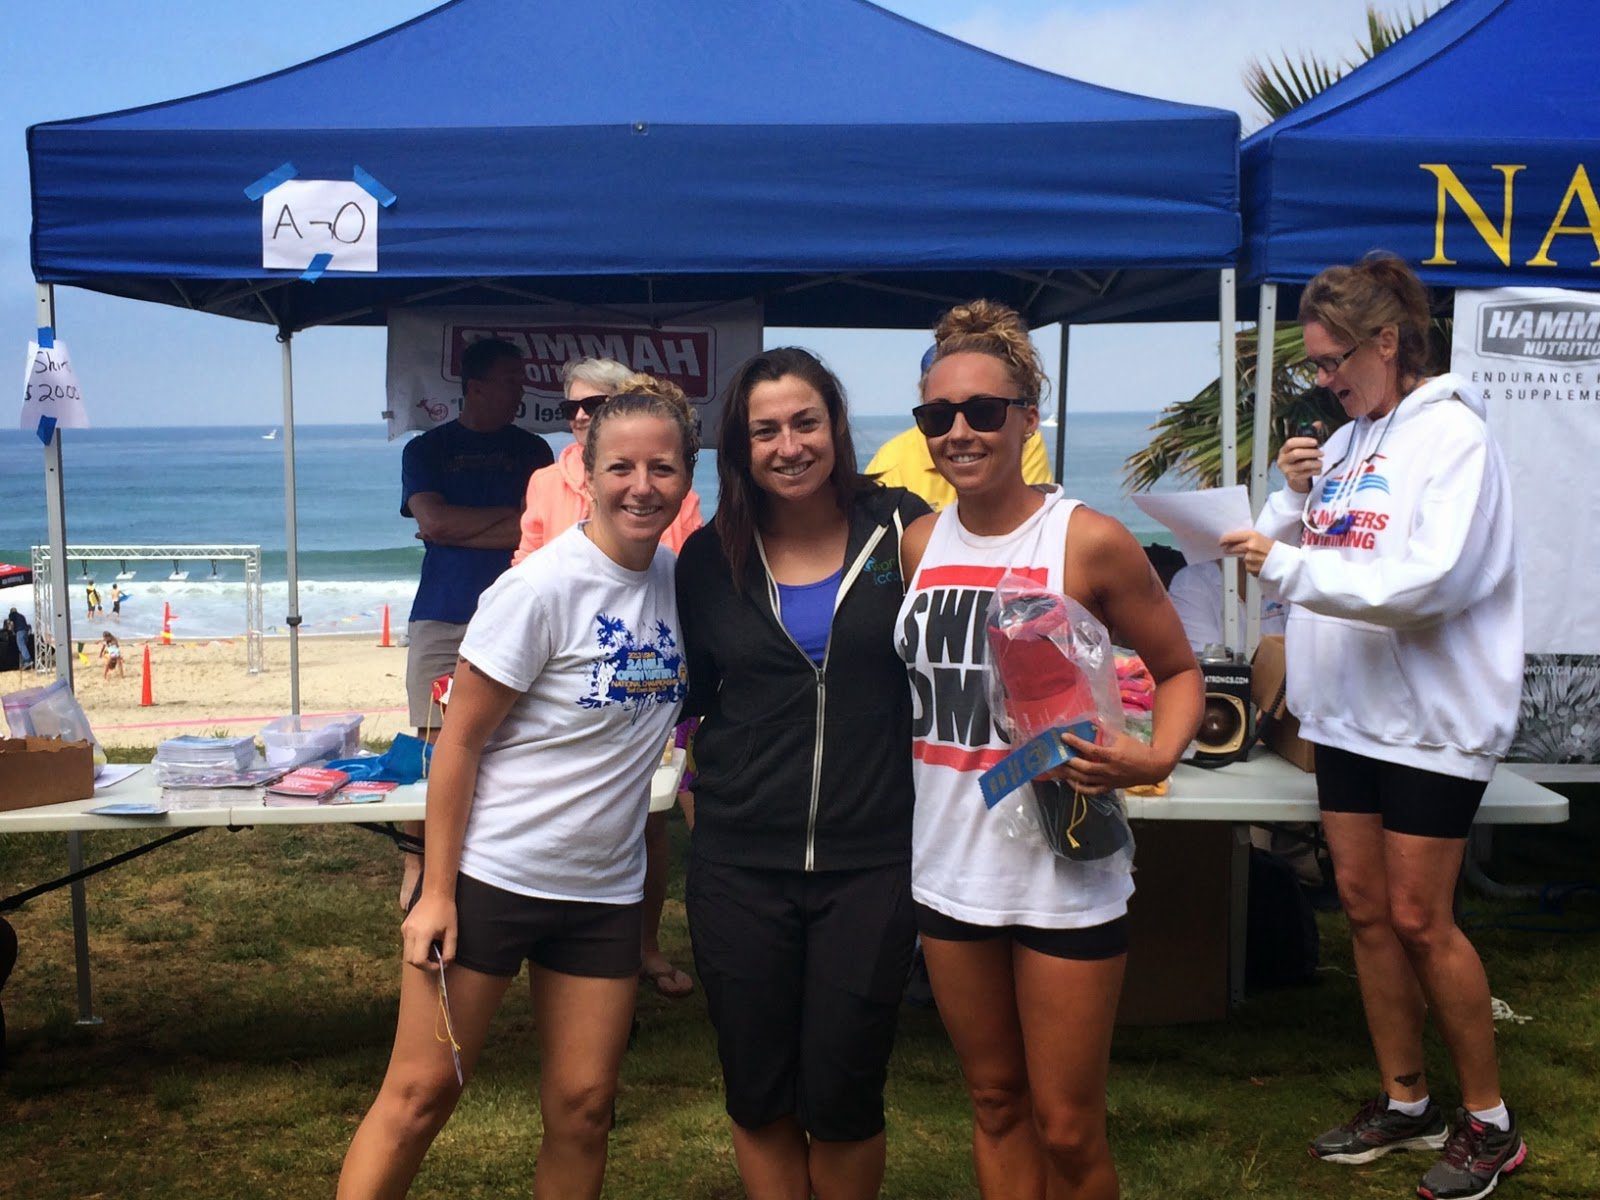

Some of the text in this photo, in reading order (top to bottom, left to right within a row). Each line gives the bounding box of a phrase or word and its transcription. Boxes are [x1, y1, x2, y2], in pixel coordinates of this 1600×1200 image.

[34, 350, 72, 374] Shir
[1472, 371, 1584, 383] ENDURANCE
[1482, 389, 1491, 399] &
[900, 589, 994, 664] SWI
